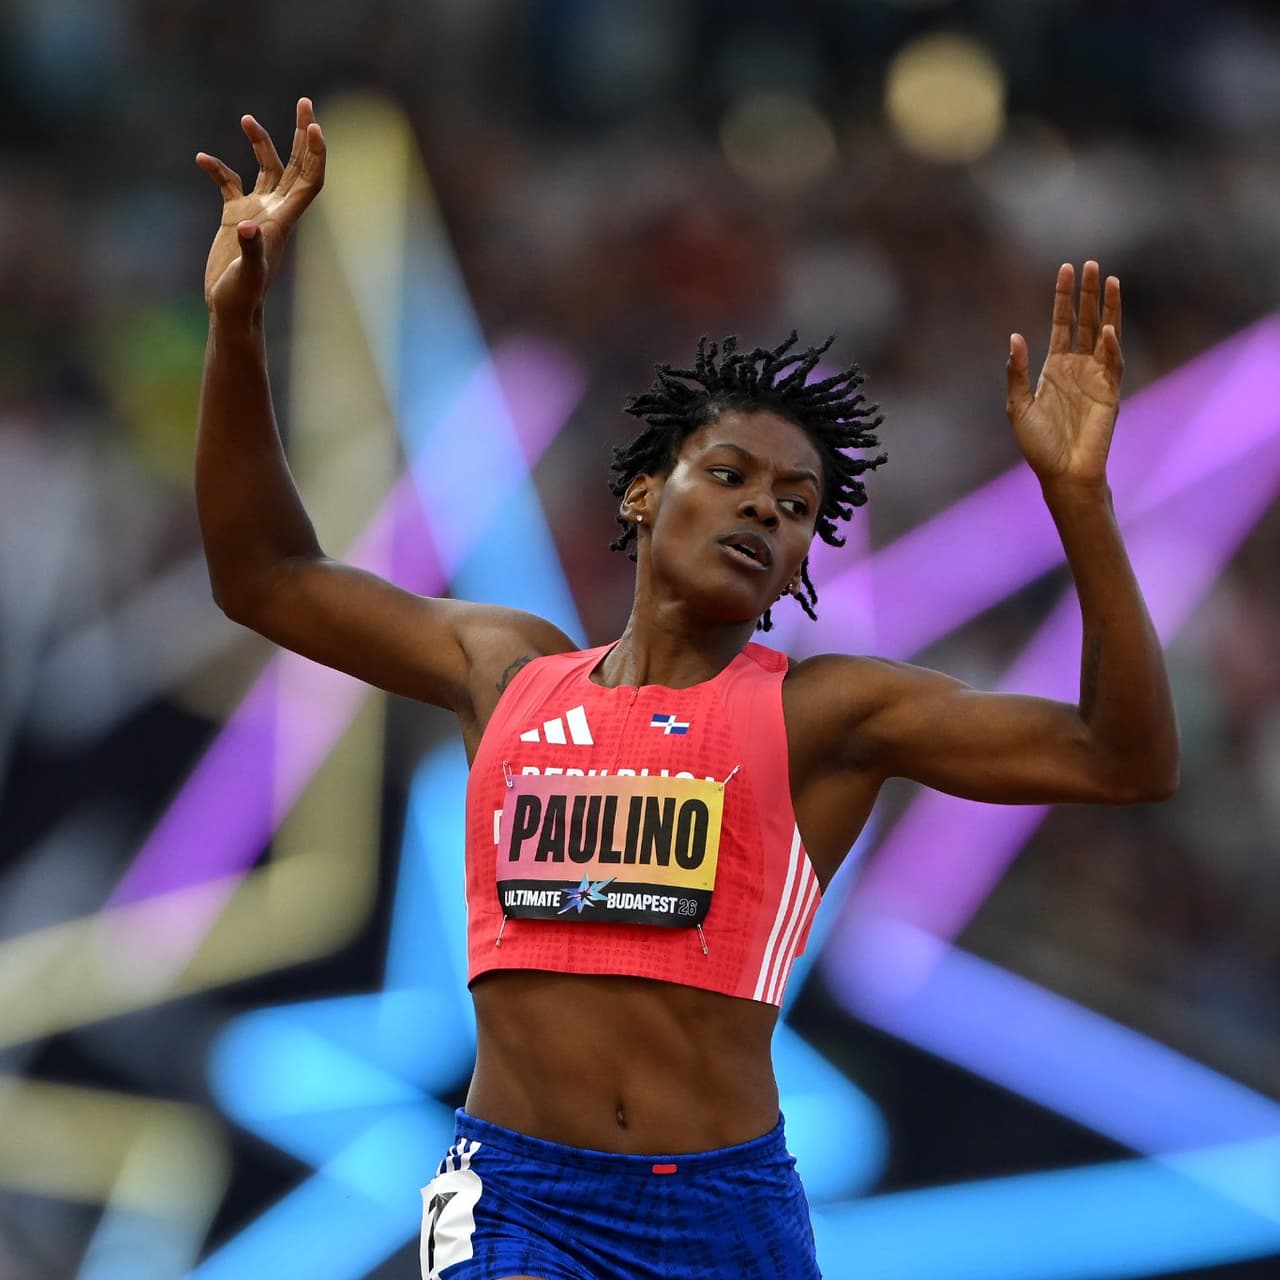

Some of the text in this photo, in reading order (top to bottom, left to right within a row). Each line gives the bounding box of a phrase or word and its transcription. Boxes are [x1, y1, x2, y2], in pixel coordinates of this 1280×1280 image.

[507, 793, 710, 871] PAULINO
[504, 889, 698, 917] ULTIMATE BUDAPEST 26
